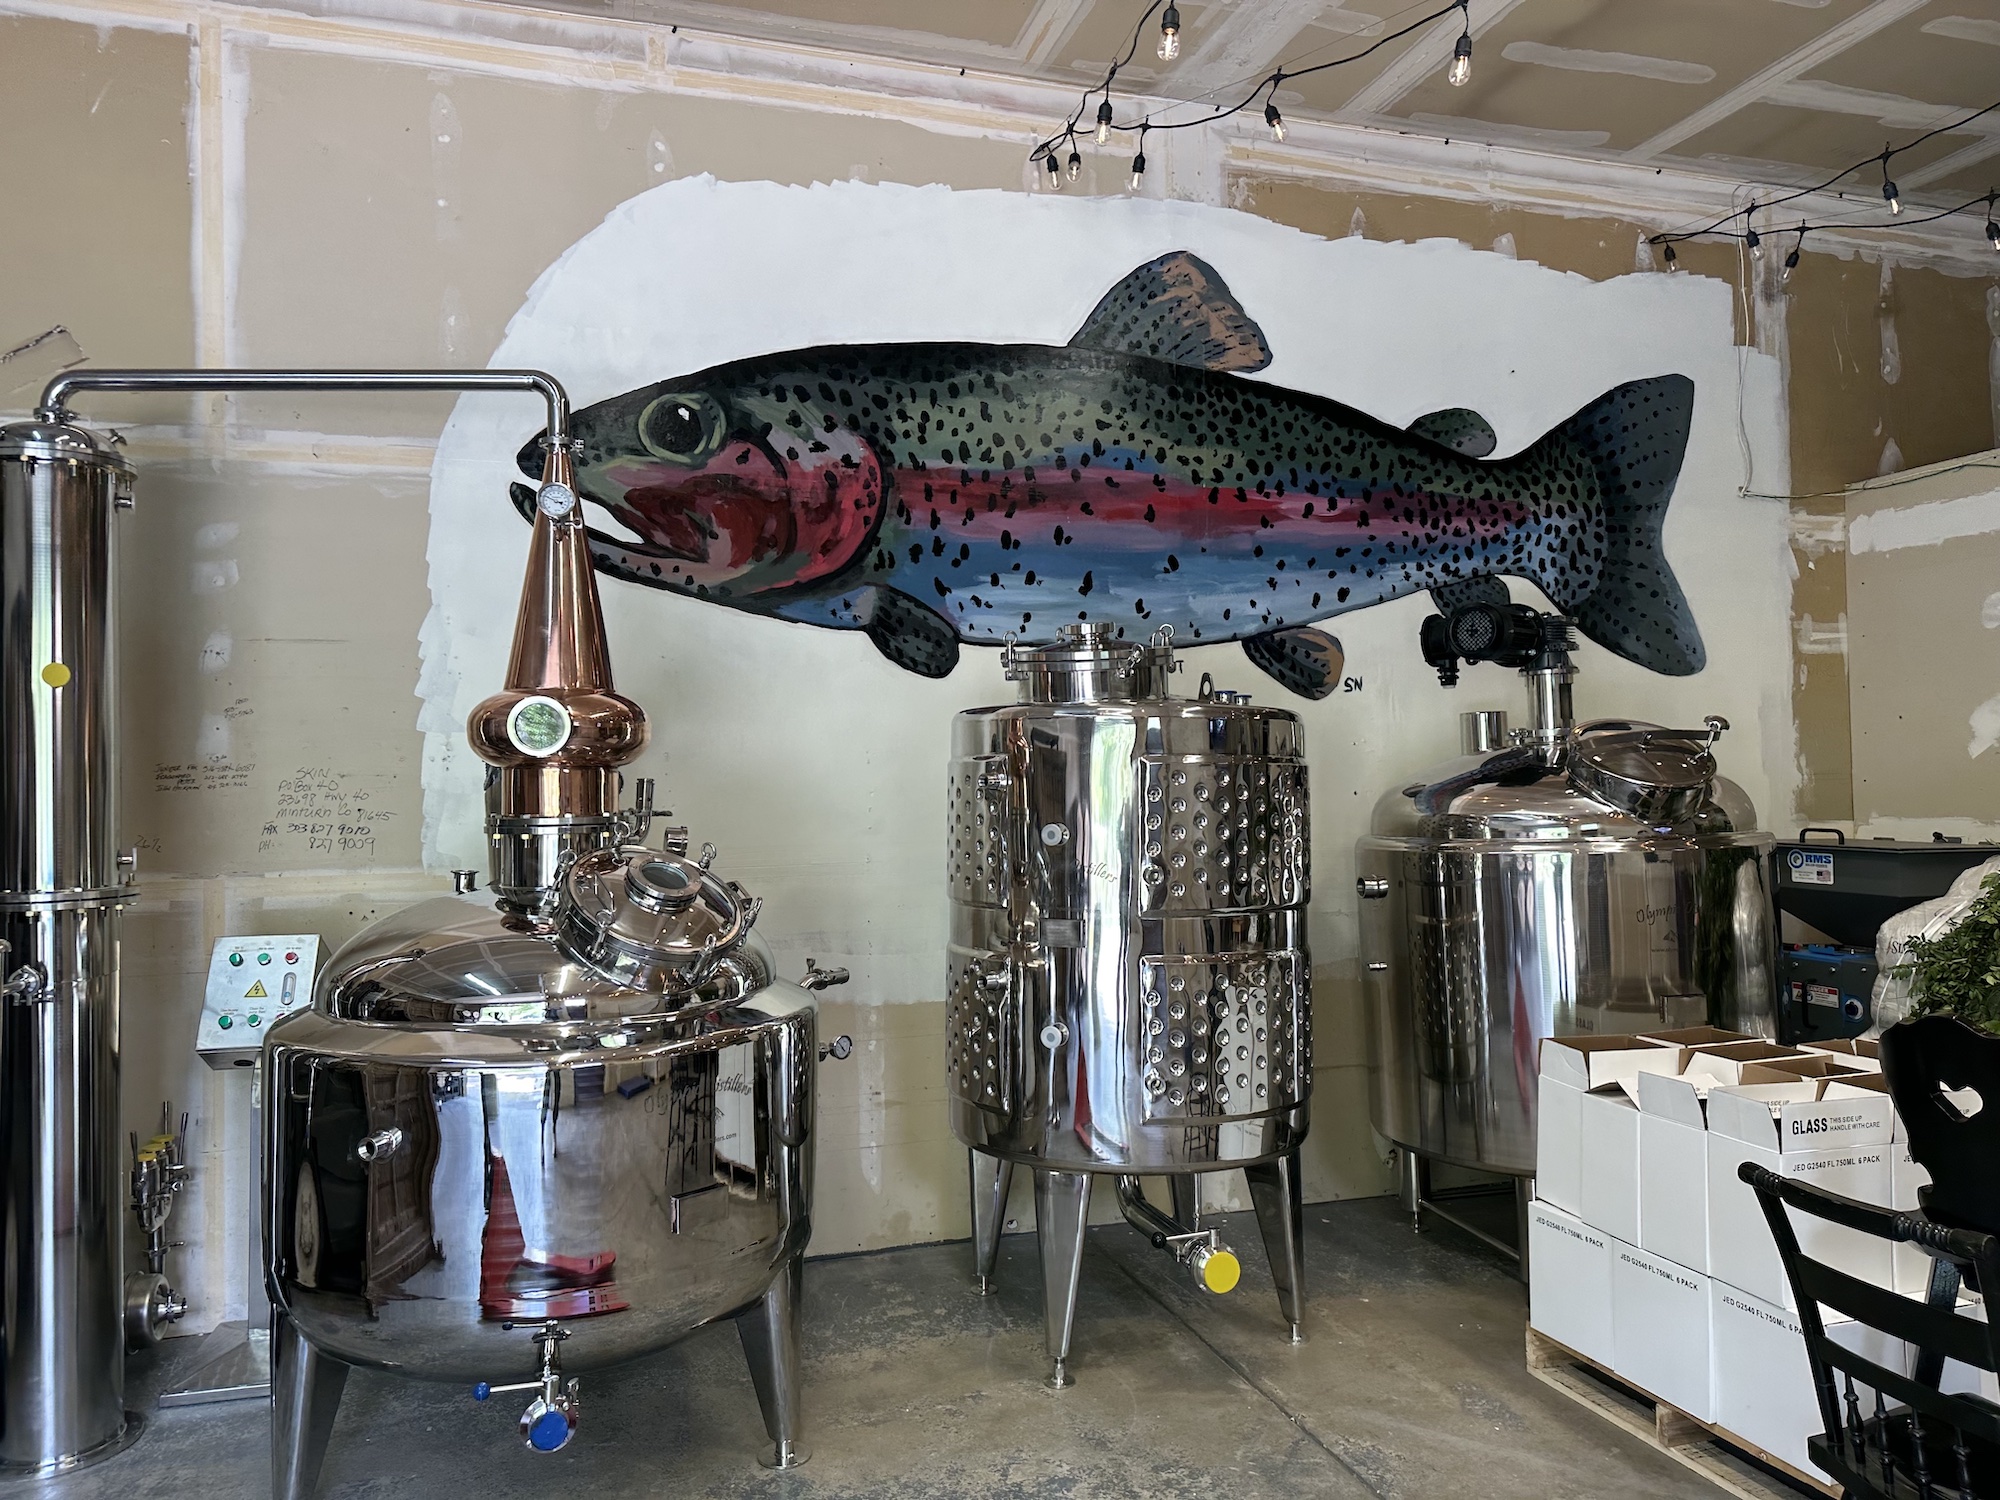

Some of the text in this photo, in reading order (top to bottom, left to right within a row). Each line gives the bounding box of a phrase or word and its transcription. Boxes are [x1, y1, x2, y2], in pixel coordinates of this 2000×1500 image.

[1344, 676, 1362, 692] SN
[295, 767, 330, 780] SKIN
[317, 780, 338, 791] 40
[353, 789, 369, 802] 40
[357, 808, 397, 822] 81645
[261, 821, 278, 836] FAX
[311, 823, 333, 836] 827
[338, 824, 371, 835] 9010
[308, 837, 332, 853] 827
[338, 838, 376, 855] 9009
[1805, 854, 1831, 864] RMS
[1792, 1118, 1828, 1135] GLASS
[1793, 1155, 1880, 1171] JED G2540 FL 750ML 6 PACK
[1536, 1217, 1545, 1225] JED
[1561, 1226, 1567, 1234] FL
[1589, 1237, 1604, 1248] PACK
[1620, 1253, 1630, 1262] JED
[1631, 1257, 1647, 1270] G2540
[1649, 1264, 1655, 1273] FL
[1656, 1268, 1674, 1281] 750ML
[1681, 1278, 1698, 1291] PACK
[1722, 1295, 1804, 1335] JED G2540 FL 750ML 6 PA
